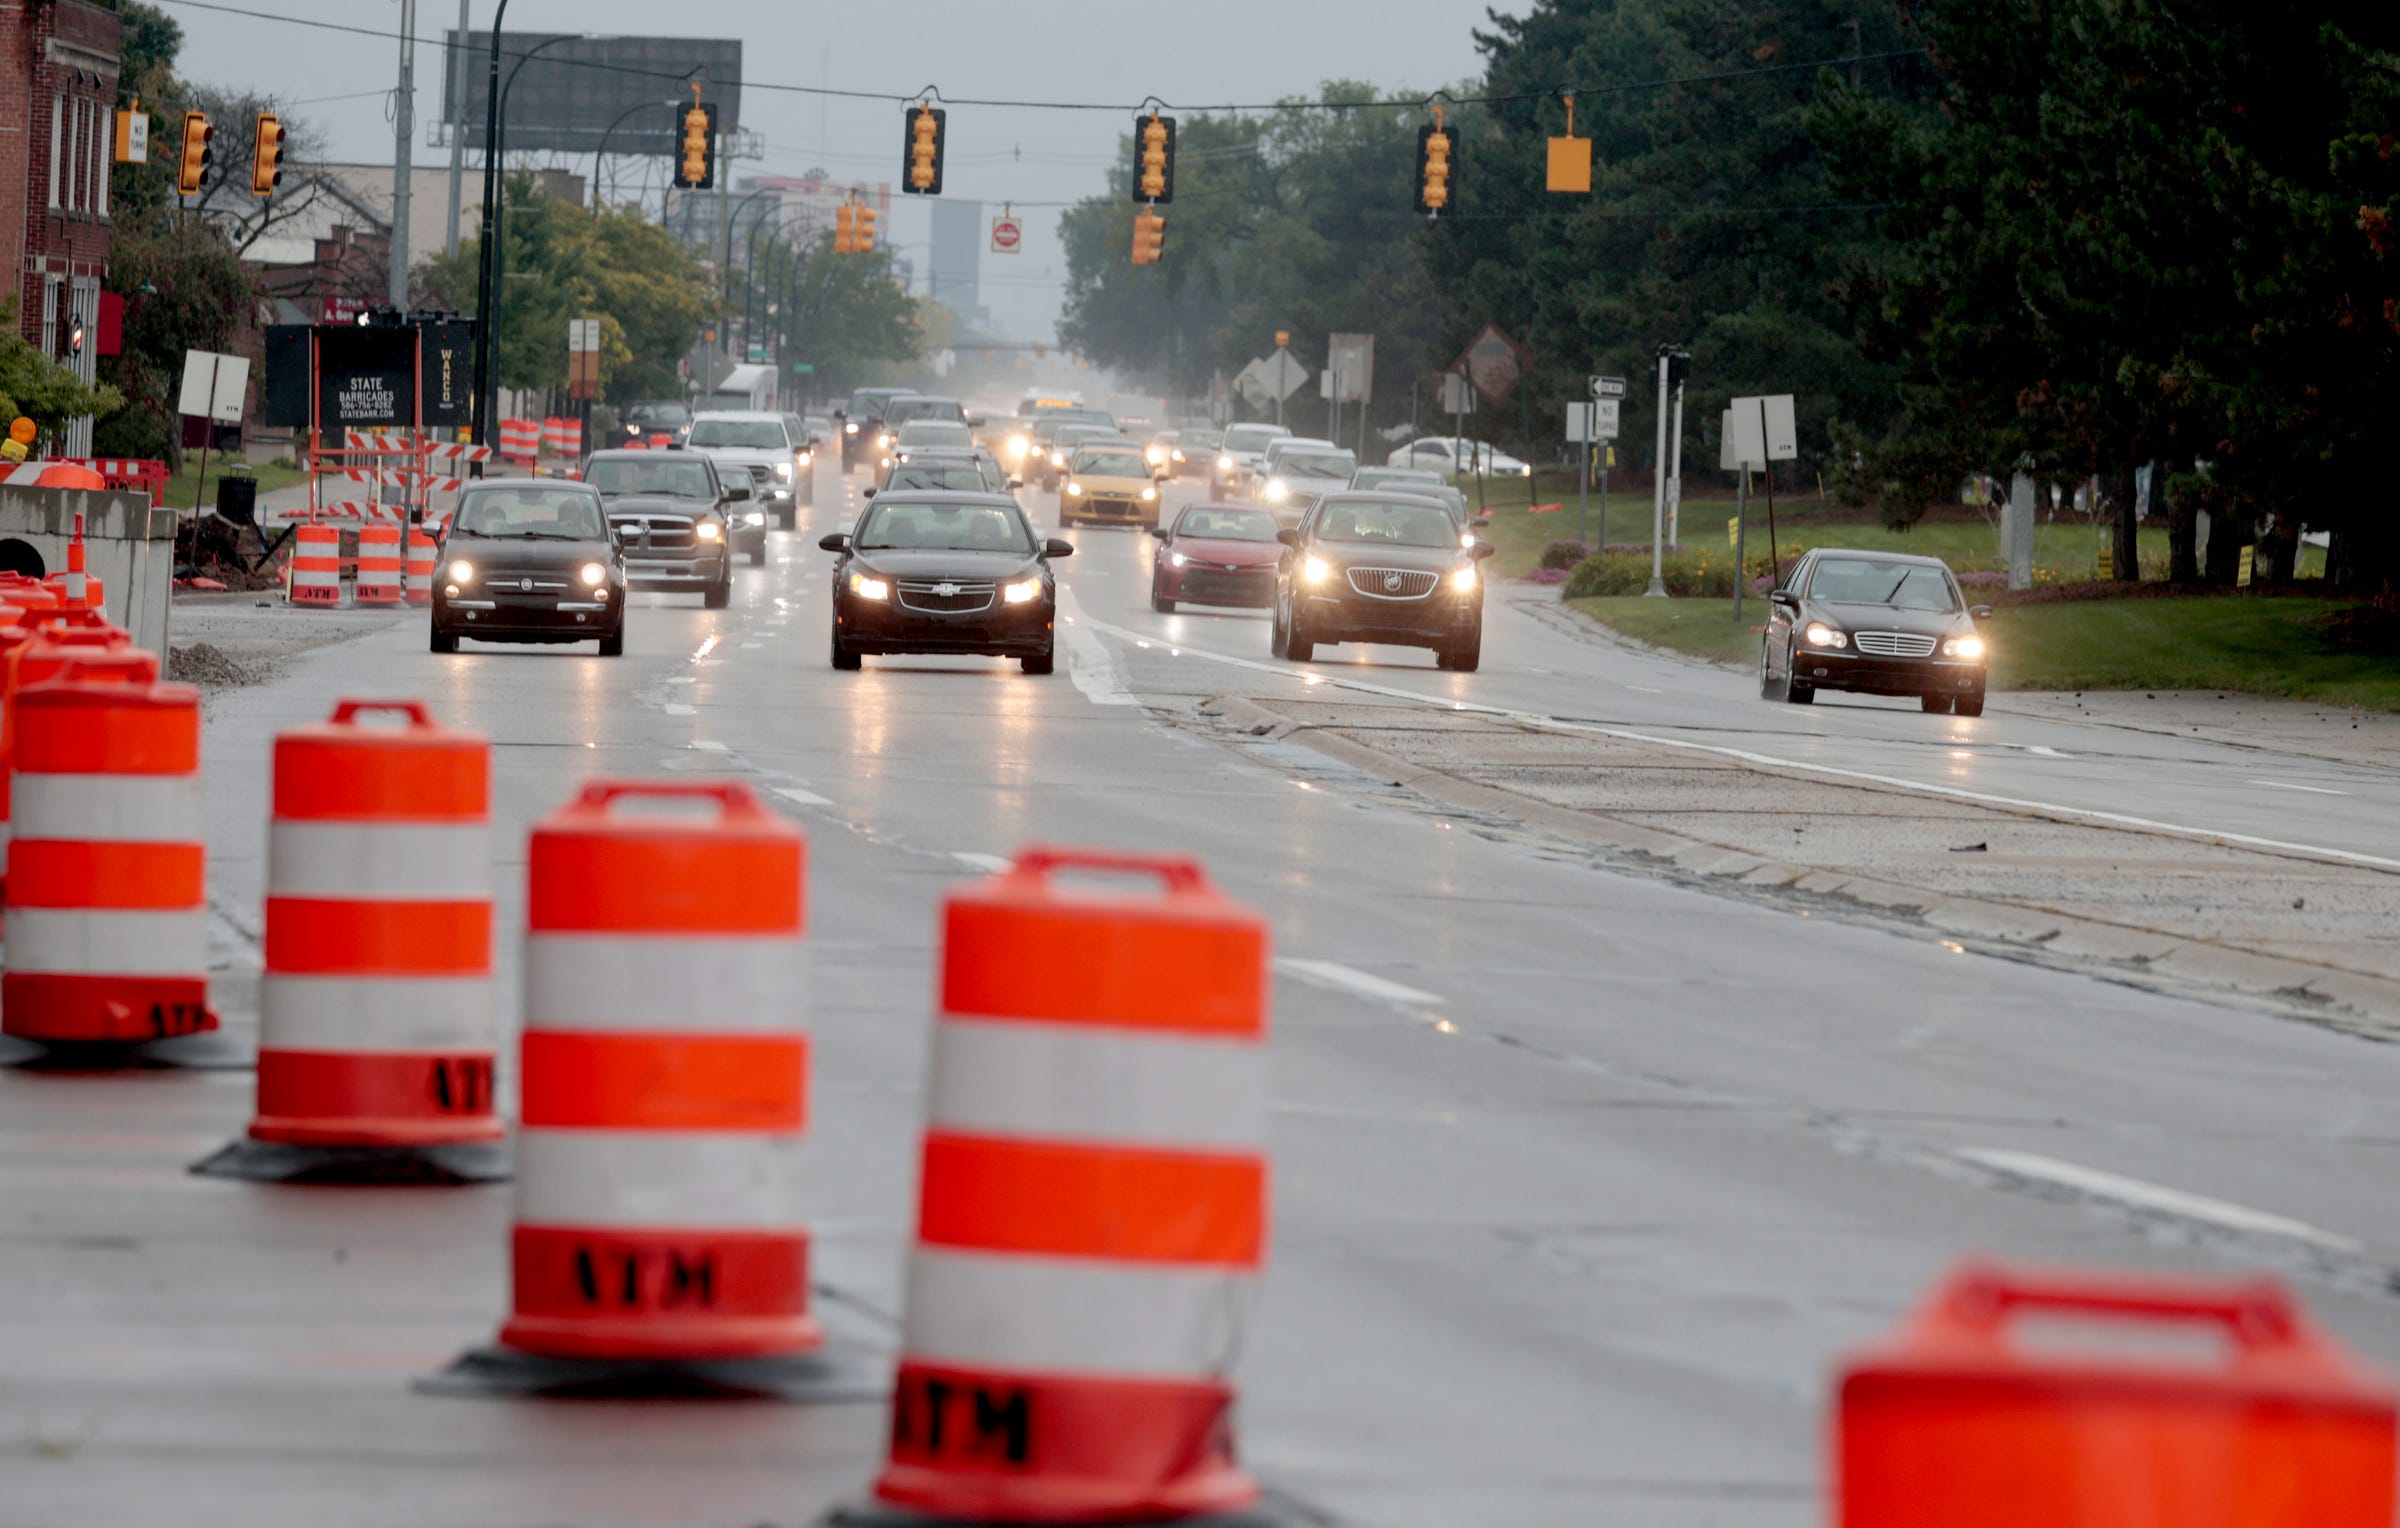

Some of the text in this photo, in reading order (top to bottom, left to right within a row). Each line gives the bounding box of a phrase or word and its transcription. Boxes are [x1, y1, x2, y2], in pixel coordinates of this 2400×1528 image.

[134, 125, 144, 137] NO
[441, 349, 452, 402] WANCO
[350, 377, 383, 391] STATE
[339, 391, 394, 402] BARRICADES
[340, 410, 394, 419] STATEBARR.COM
[1602, 405, 1613, 416] NO
[305, 588, 330, 599] ATM
[430, 1058, 494, 1110] AT
[569, 1247, 715, 1306] ATM
